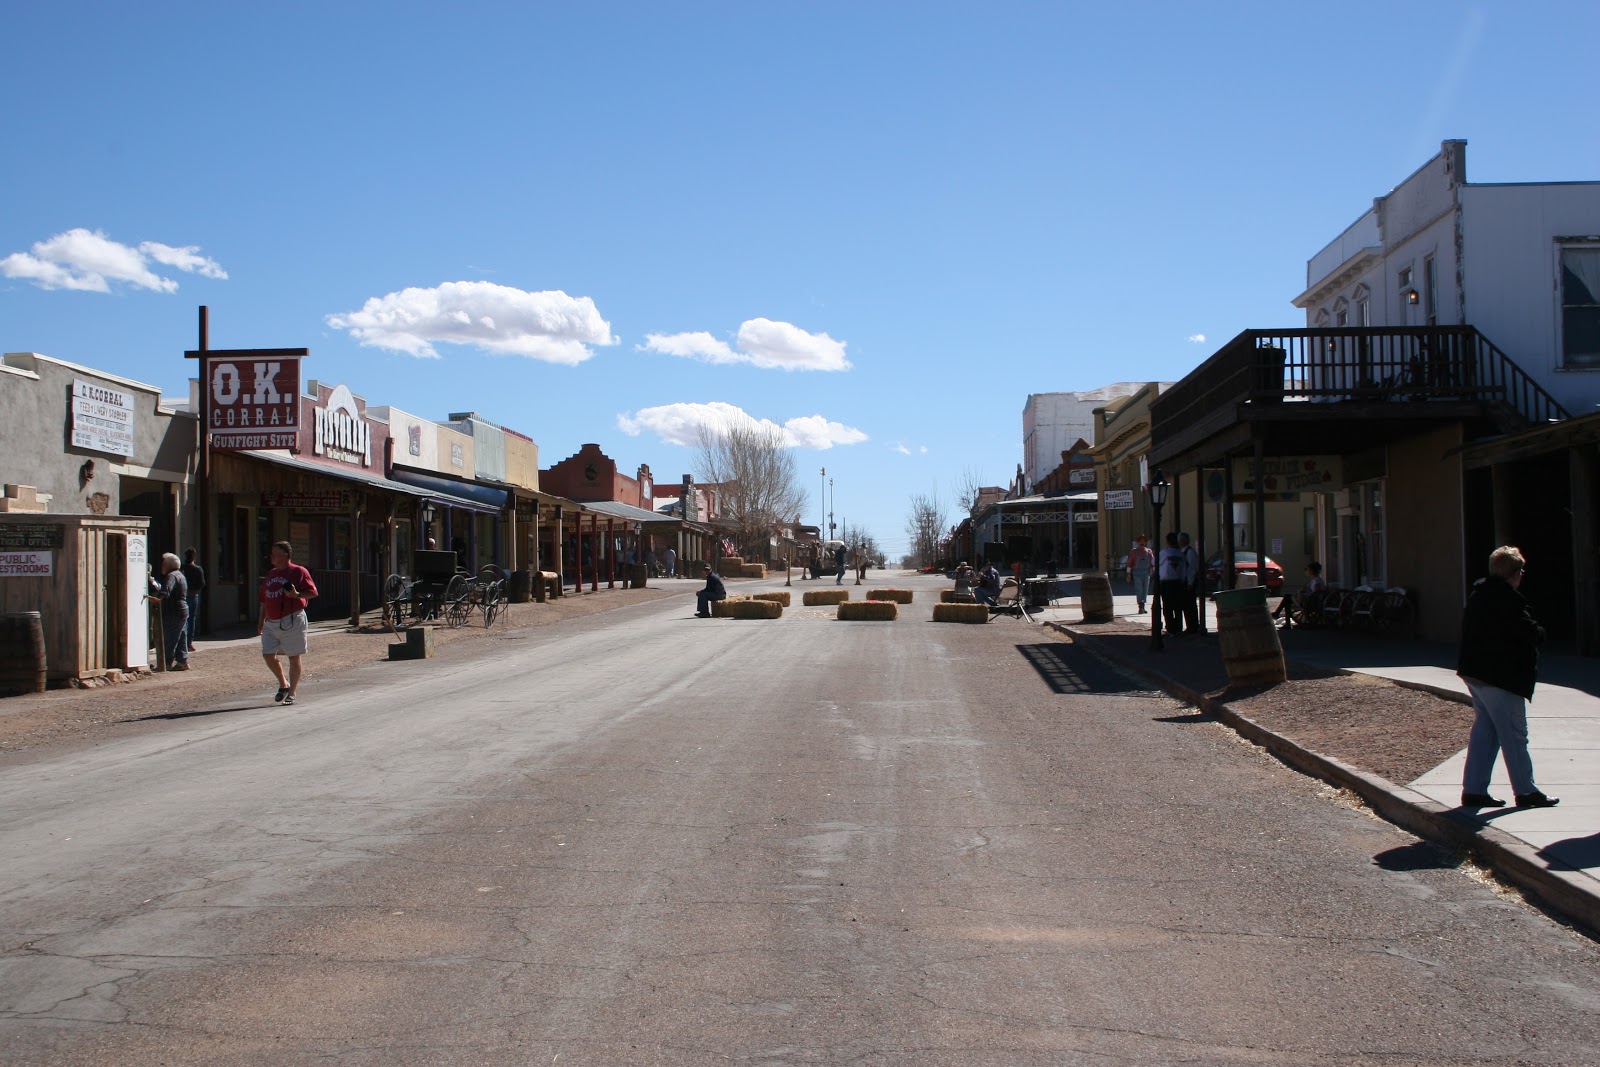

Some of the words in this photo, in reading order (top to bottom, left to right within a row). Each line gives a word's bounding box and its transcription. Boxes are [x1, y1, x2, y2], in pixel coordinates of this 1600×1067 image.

[212, 363, 292, 405] O.K.
[213, 407, 293, 426] CORRAL
[213, 435, 267, 448] GUNFIGHT
[270, 434, 295, 447] SITE
[315, 406, 371, 466] HISTORAMA
[282, 498, 320, 506] GUNFIGHT
[322, 498, 340, 506] SITE
[28, 538, 52, 546] OFFICE
[0, 554, 36, 564] PUBLIC
[0, 564, 49, 573] ESTROOMS
